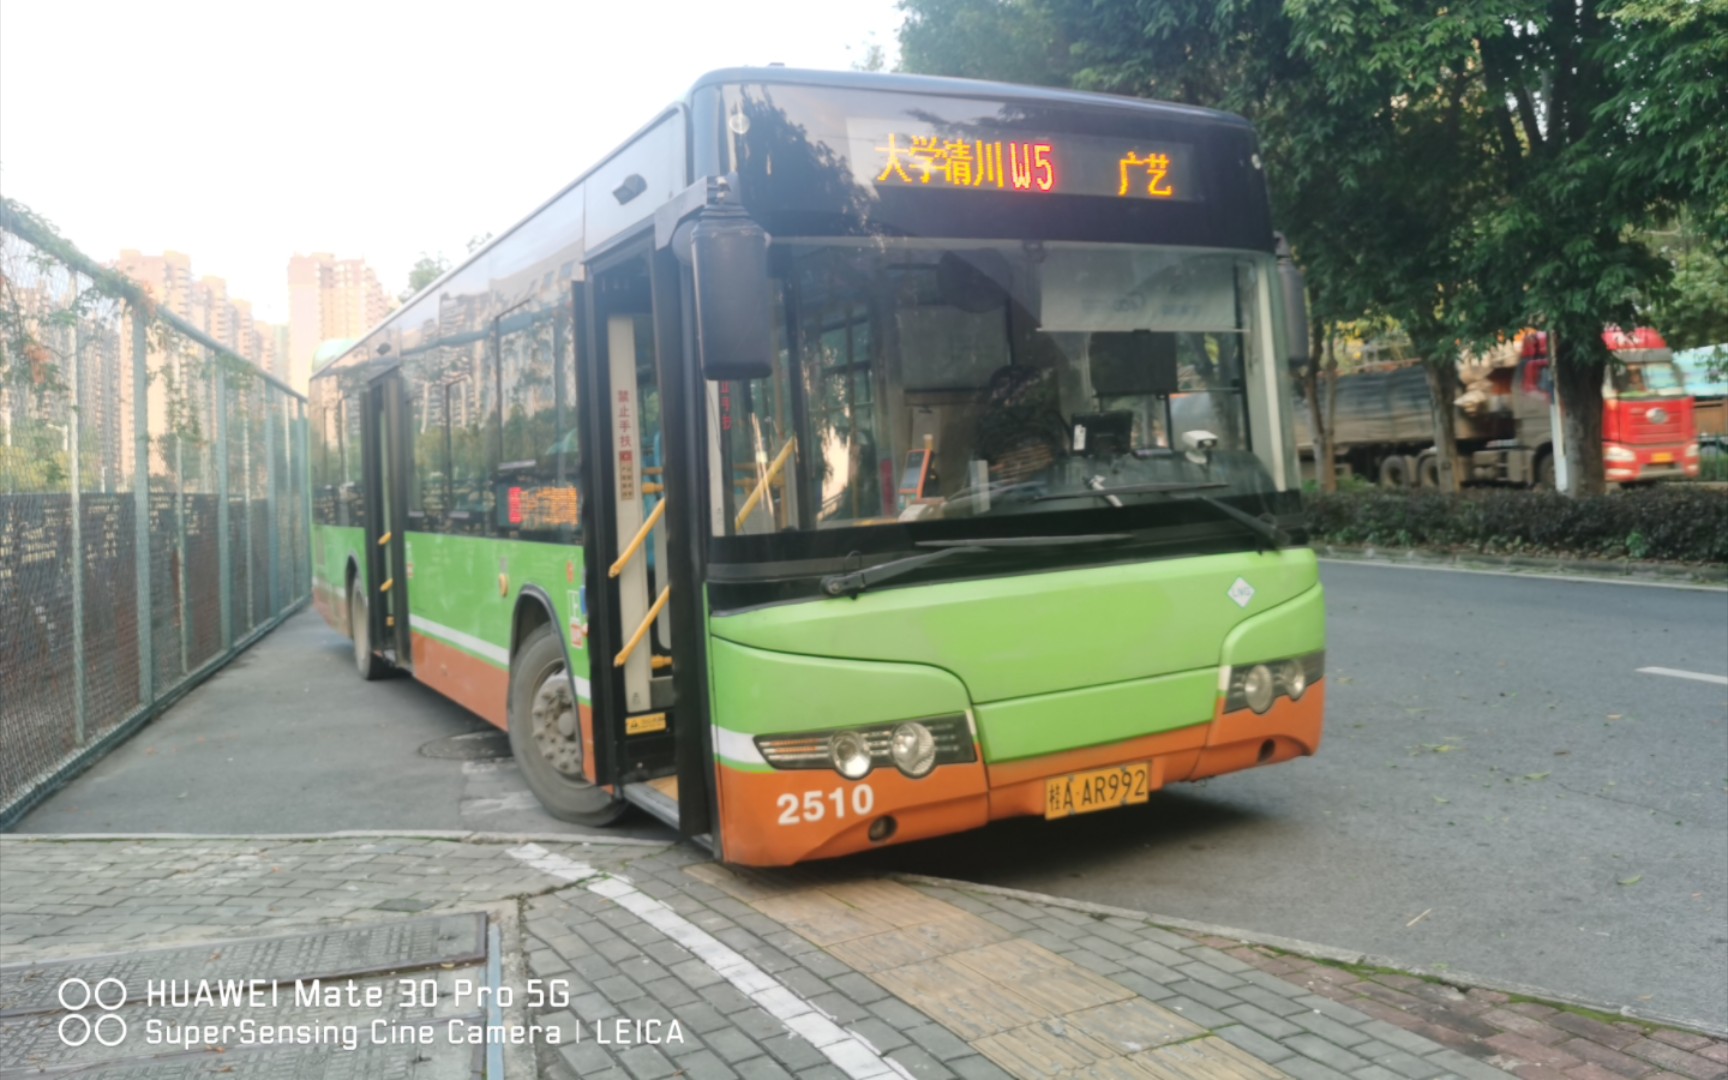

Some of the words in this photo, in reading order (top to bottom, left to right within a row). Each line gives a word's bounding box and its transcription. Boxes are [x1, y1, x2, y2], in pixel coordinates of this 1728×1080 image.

[877, 132, 1004, 188] 大学清川
[1009, 141, 1056, 191] W5
[1118, 151, 1172, 196] 广艺
[777, 784, 874, 825] 2510
